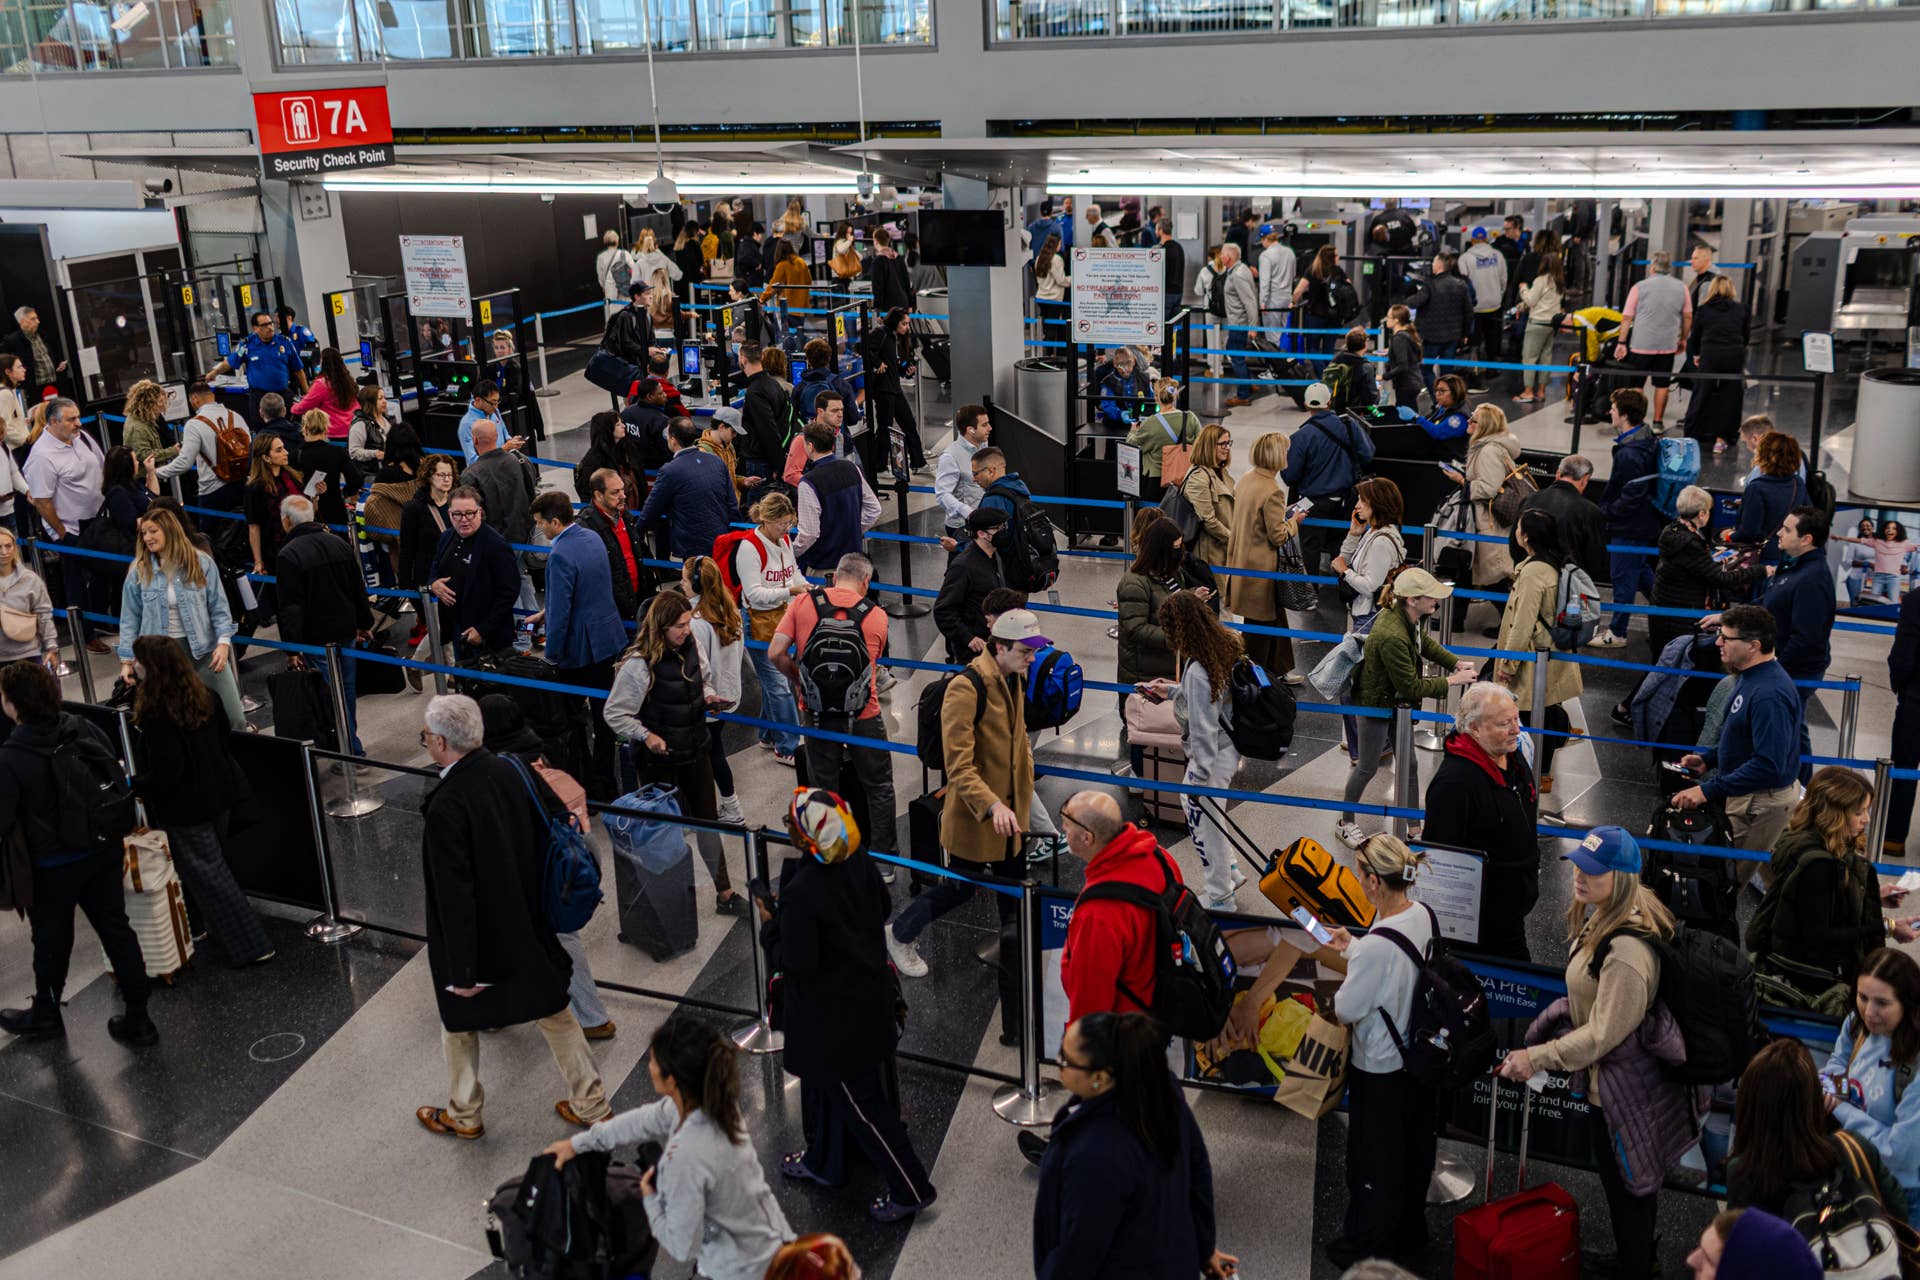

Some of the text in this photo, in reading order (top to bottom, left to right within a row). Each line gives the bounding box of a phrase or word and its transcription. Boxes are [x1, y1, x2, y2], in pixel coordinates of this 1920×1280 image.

[323, 99, 368, 135] 7A
[274, 149, 386, 172] Security Check Point
[1102, 252, 1136, 260] ATTENTION
[184, 289, 191, 302] 6
[1076, 284, 1160, 293] NO FIREARMS ARE ALLOWED
[1093, 292, 1108, 300] PAST
[334, 300, 343, 314] 5
[483, 307, 490, 321] 4
[724, 310, 730, 326] 3
[837, 319, 843, 335] 2
[625, 422, 641, 438] TSA
[1050, 904, 1074, 920] TSA
[1495, 992, 1516, 1005] With
[1517, 997, 1537, 1009] Ease
[1292, 1031, 1344, 1079] NIK
[1474, 1081, 1519, 1099] Chidren
[1540, 1096, 1561, 1107] and
[1563, 1099, 1590, 1114] unde
[1496, 1100, 1517, 1112] you
[1538, 1105, 1563, 1120] free.
